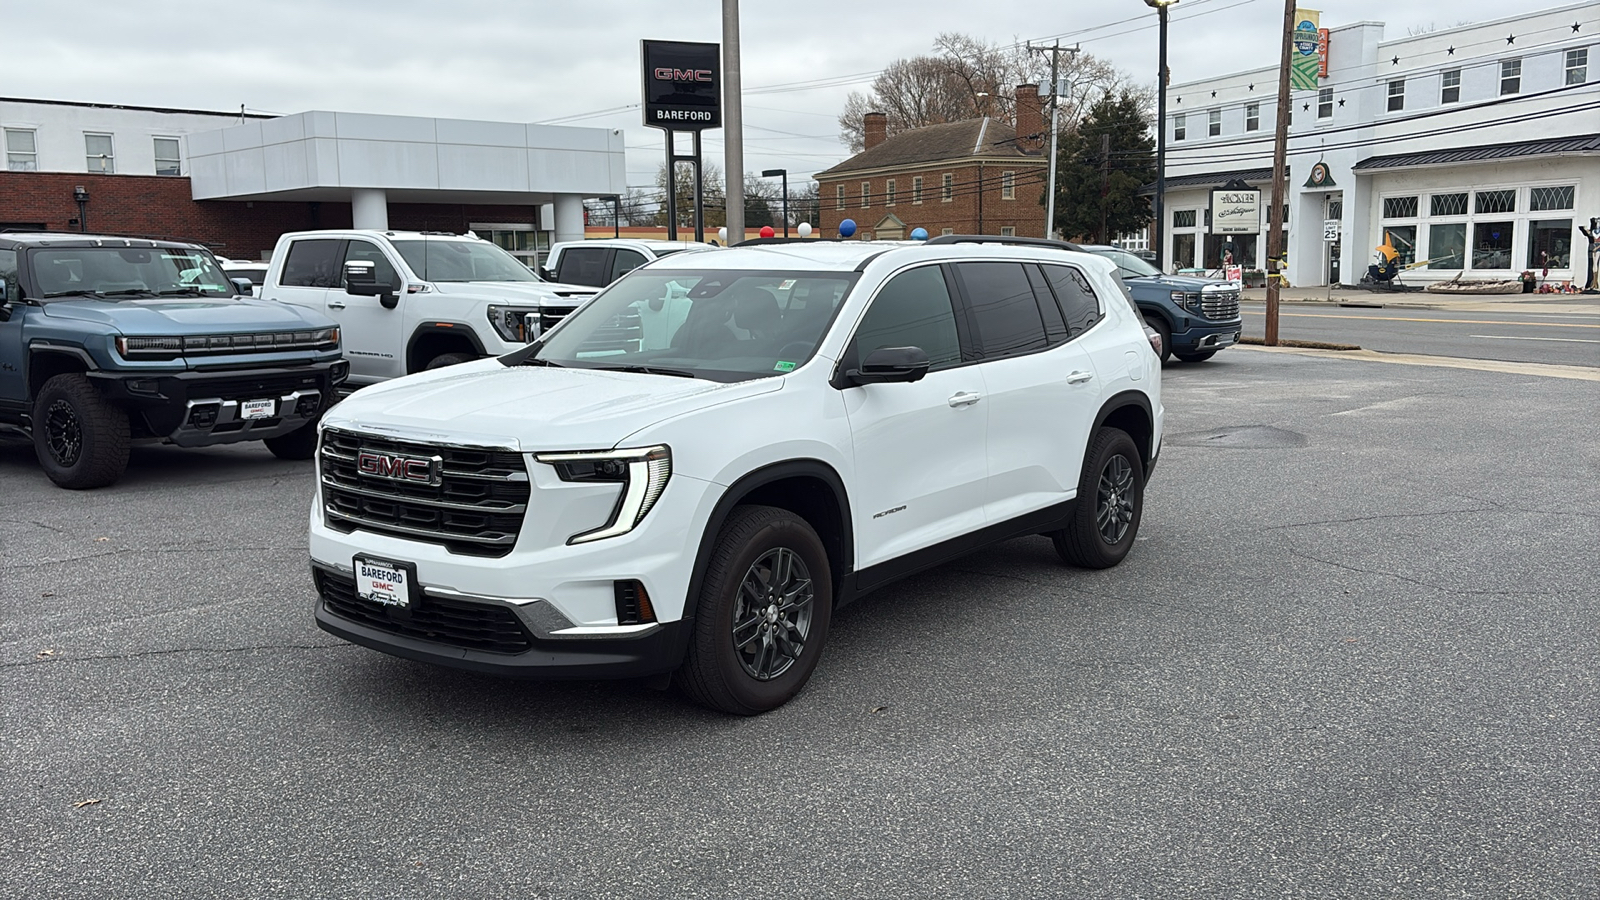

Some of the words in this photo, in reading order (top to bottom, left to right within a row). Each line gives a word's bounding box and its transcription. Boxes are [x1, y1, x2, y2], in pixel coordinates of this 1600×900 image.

[654, 67, 712, 81] GMC
[657, 110, 711, 120] BAREFORD
[1325, 230, 1336, 239] 25
[359, 453, 430, 481] GMC
[873, 505, 907, 520] ACADIA
[361, 566, 403, 584] BAREFORD
[372, 581, 394, 591] GMC
